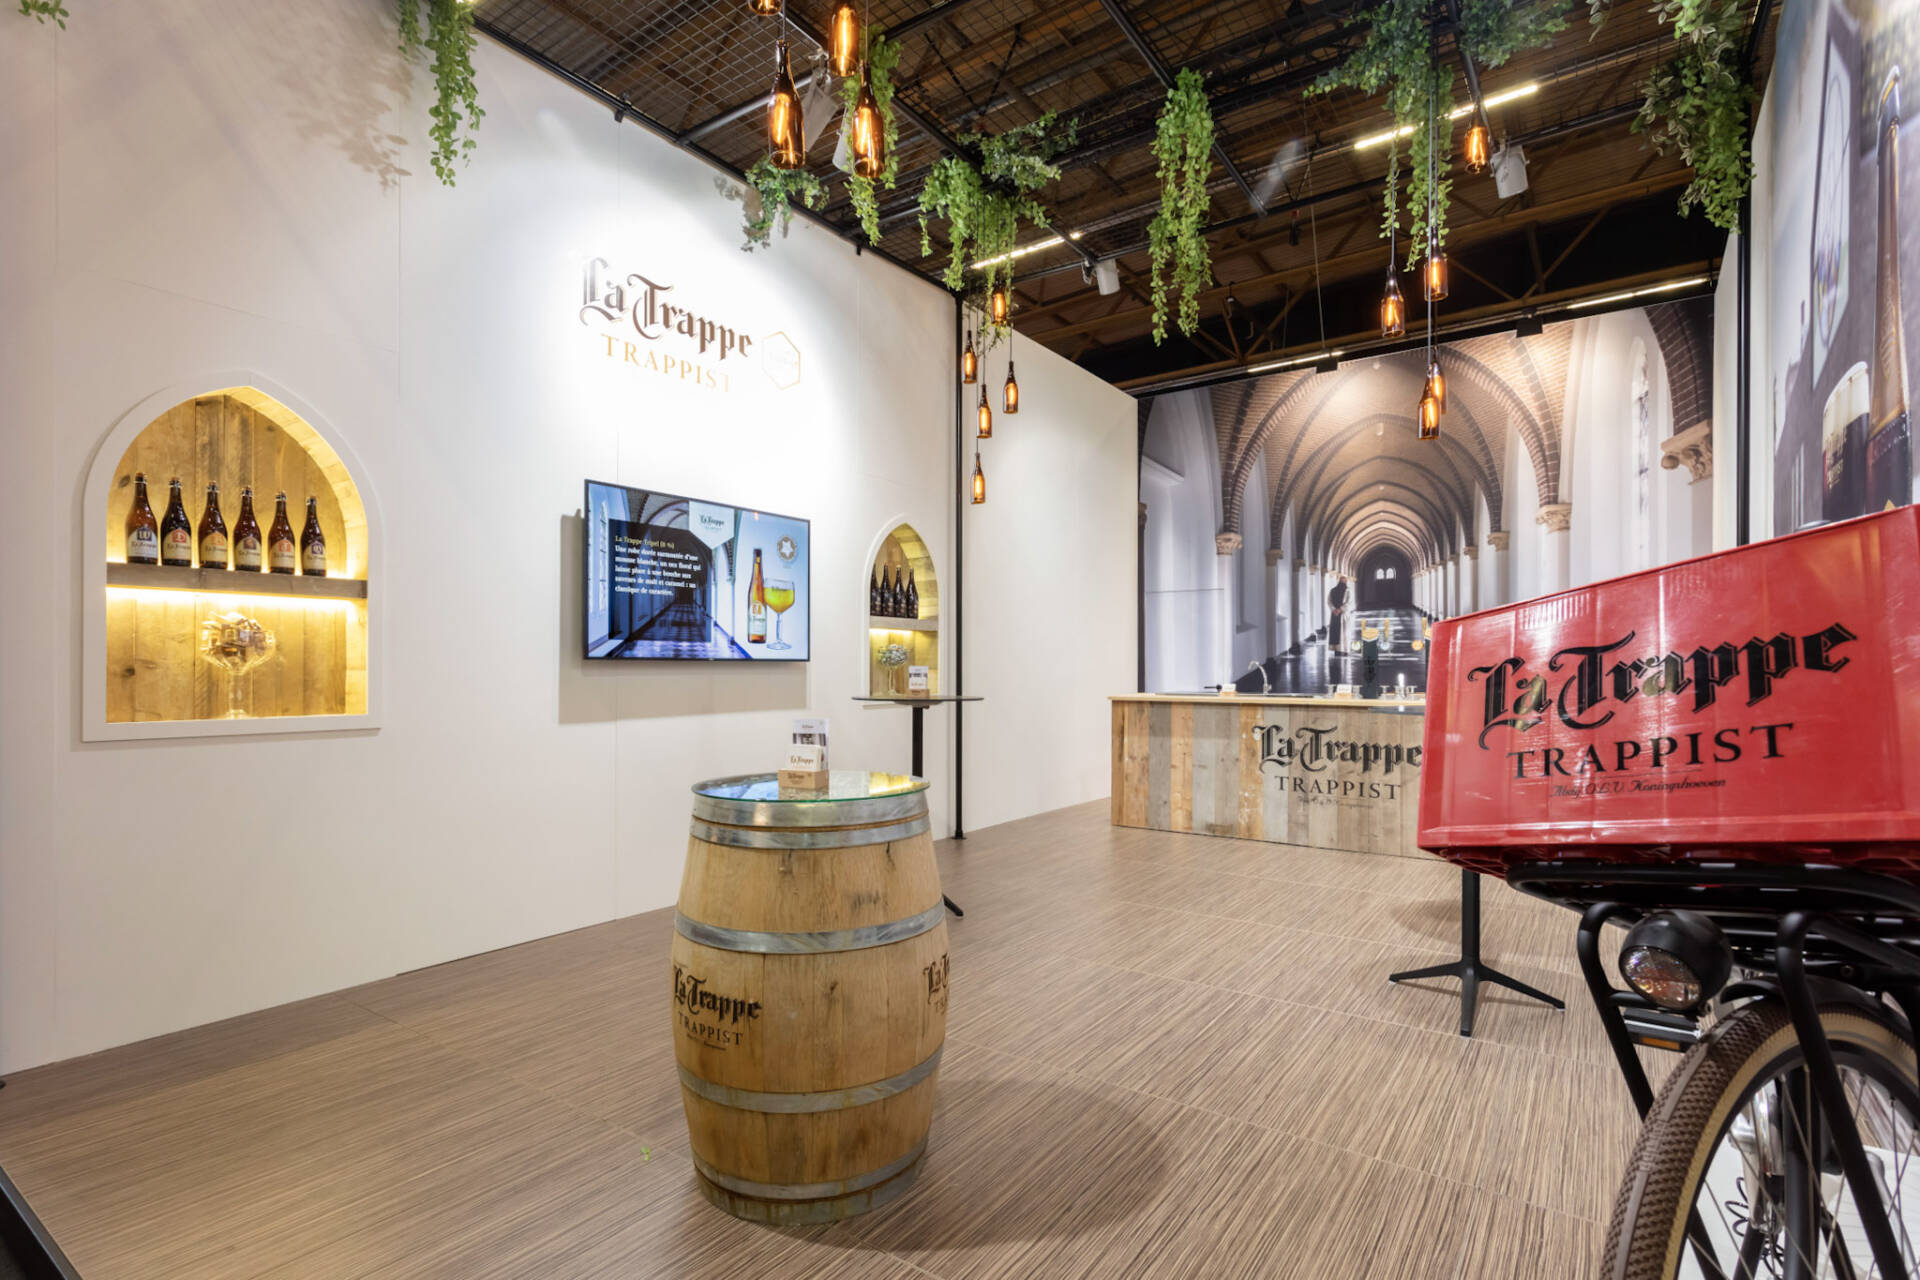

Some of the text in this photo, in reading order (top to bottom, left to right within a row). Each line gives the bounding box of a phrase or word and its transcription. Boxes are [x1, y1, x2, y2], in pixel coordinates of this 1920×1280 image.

[579, 257, 753, 361] La Trappe
[601, 333, 730, 393] TRAPPIST
[1467, 622, 1858, 750] La Trappe
[1252, 724, 1423, 776] La Trappe
[1507, 722, 1794, 779] TRAPPIST
[1274, 776, 1401, 801] TRAPPIST
[686, 975, 763, 1025] Trappe
[678, 1010, 745, 1046] TRAPPIST
